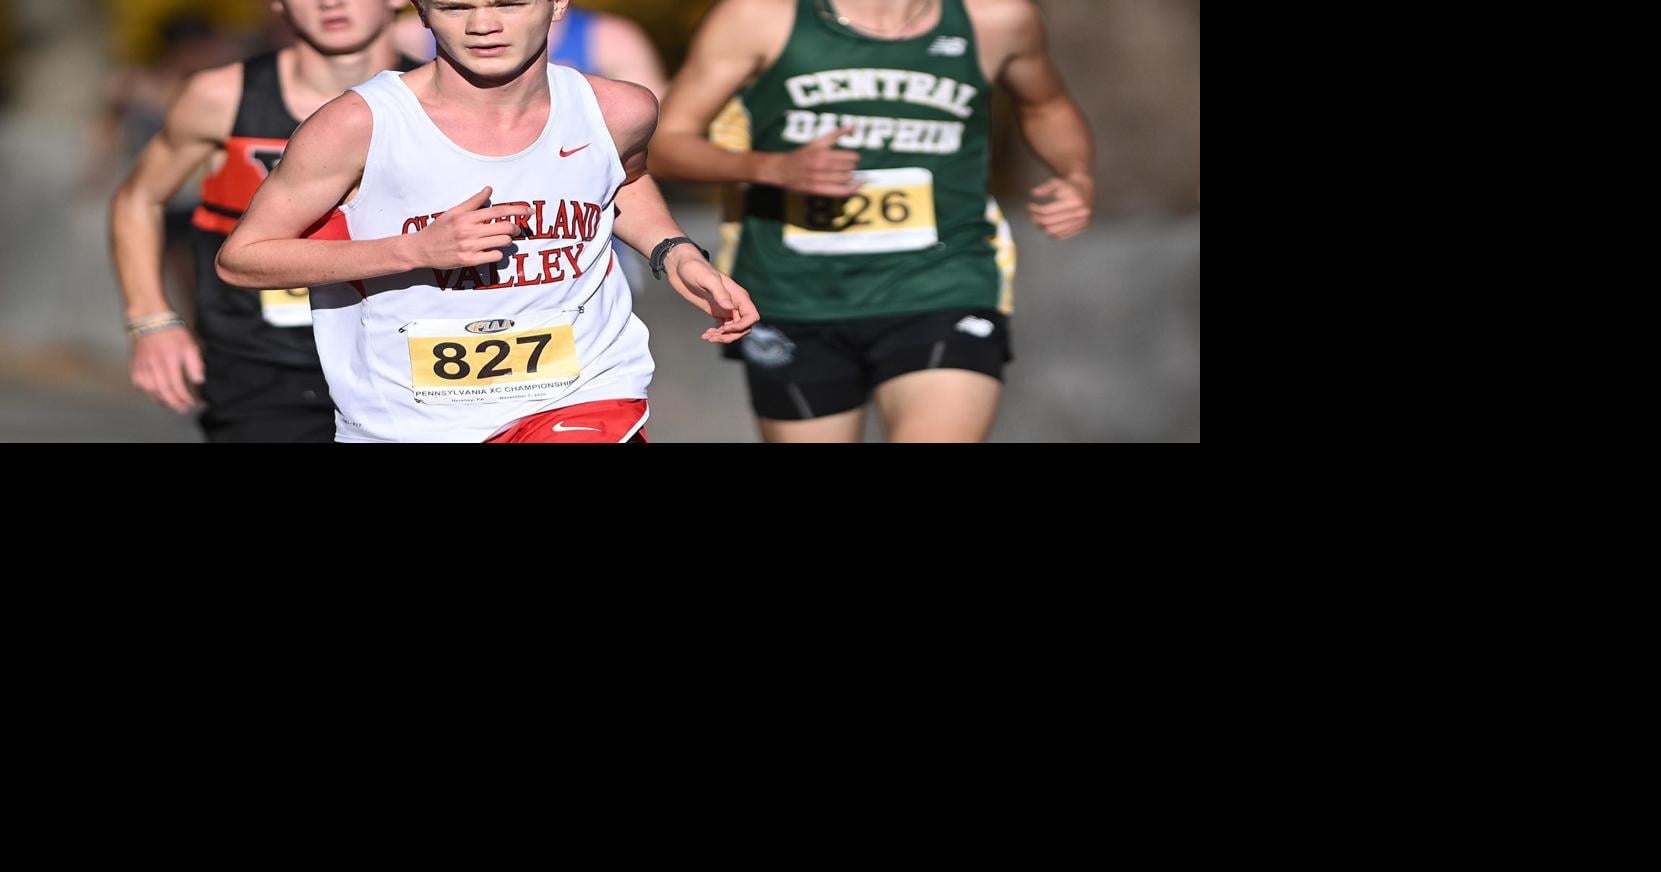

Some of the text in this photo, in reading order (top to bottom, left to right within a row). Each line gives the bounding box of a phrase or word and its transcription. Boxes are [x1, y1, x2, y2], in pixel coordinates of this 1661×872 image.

[786, 69, 976, 117] CENTRAL
[782, 110, 965, 154] DAUPHIN
[401, 199, 601, 242] CUERLAND
[432, 243, 585, 291] VALLEY
[432, 333, 552, 380] 827
